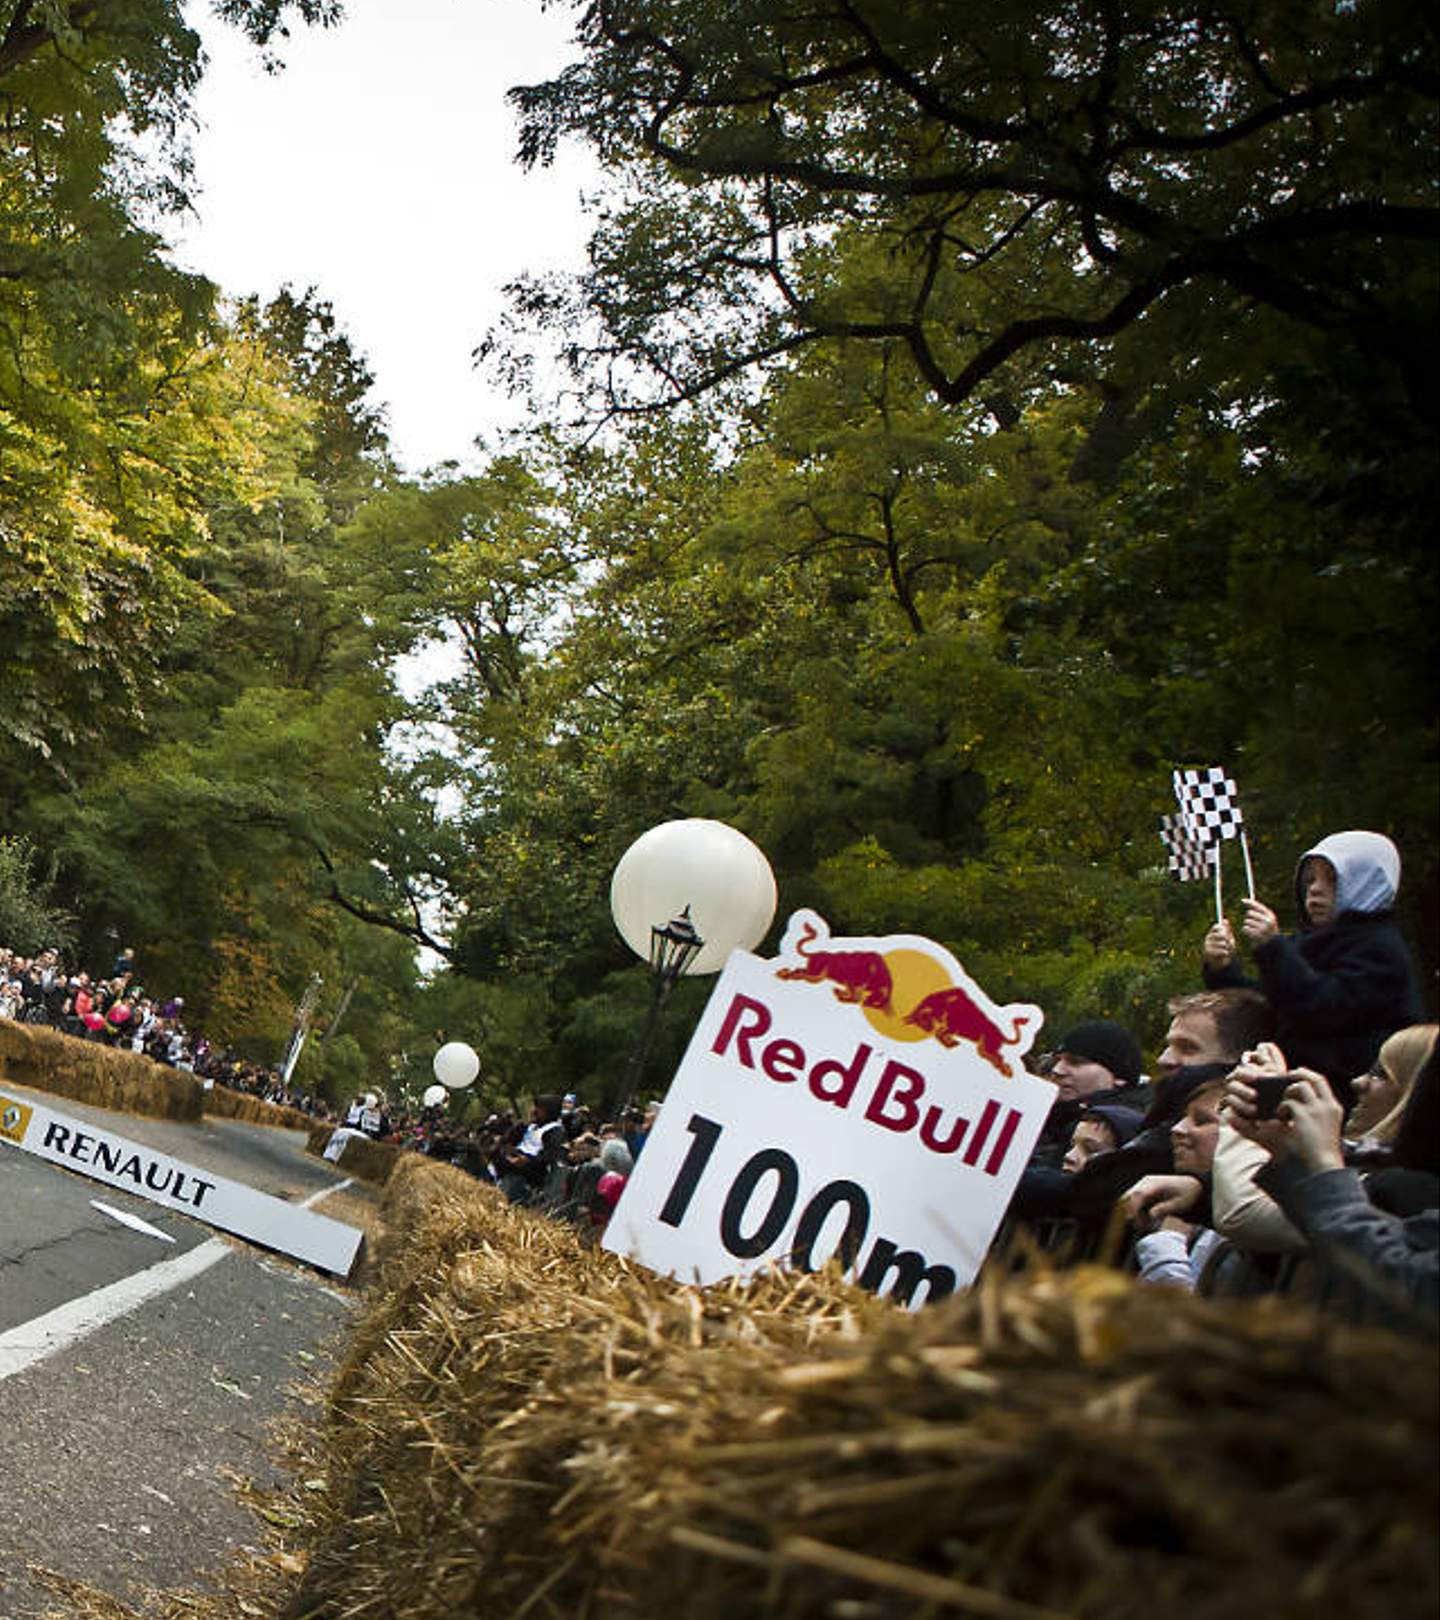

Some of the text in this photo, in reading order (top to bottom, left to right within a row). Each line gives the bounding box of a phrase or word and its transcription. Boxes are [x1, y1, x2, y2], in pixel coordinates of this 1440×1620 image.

[710, 993, 1023, 1178] Red Bull
[43, 1121, 216, 1207] RENAULT
